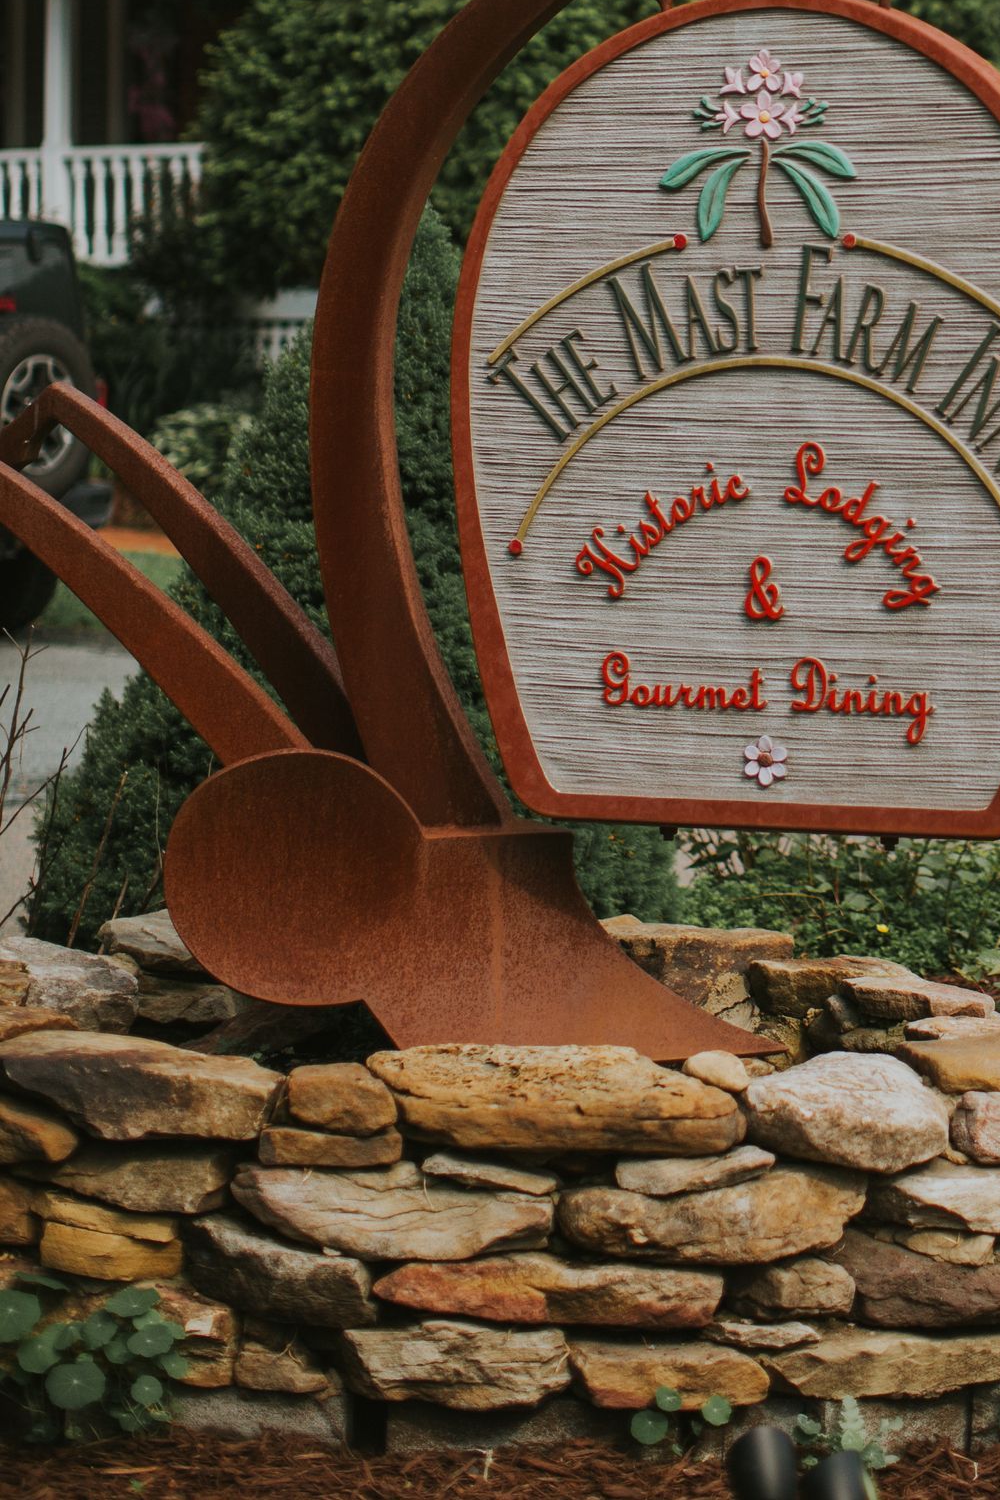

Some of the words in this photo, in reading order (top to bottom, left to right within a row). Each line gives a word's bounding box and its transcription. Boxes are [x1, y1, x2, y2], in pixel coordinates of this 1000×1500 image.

[487, 328, 618, 443] THE
[606, 262, 764, 380] MAST
[790, 243, 944, 393] FARM
[575, 461, 750, 598] Historic
[783, 441, 941, 609] Lodging
[744, 555, 784, 620] &
[601, 650, 767, 710] Gourmet
[790, 656, 935, 745] Dining
